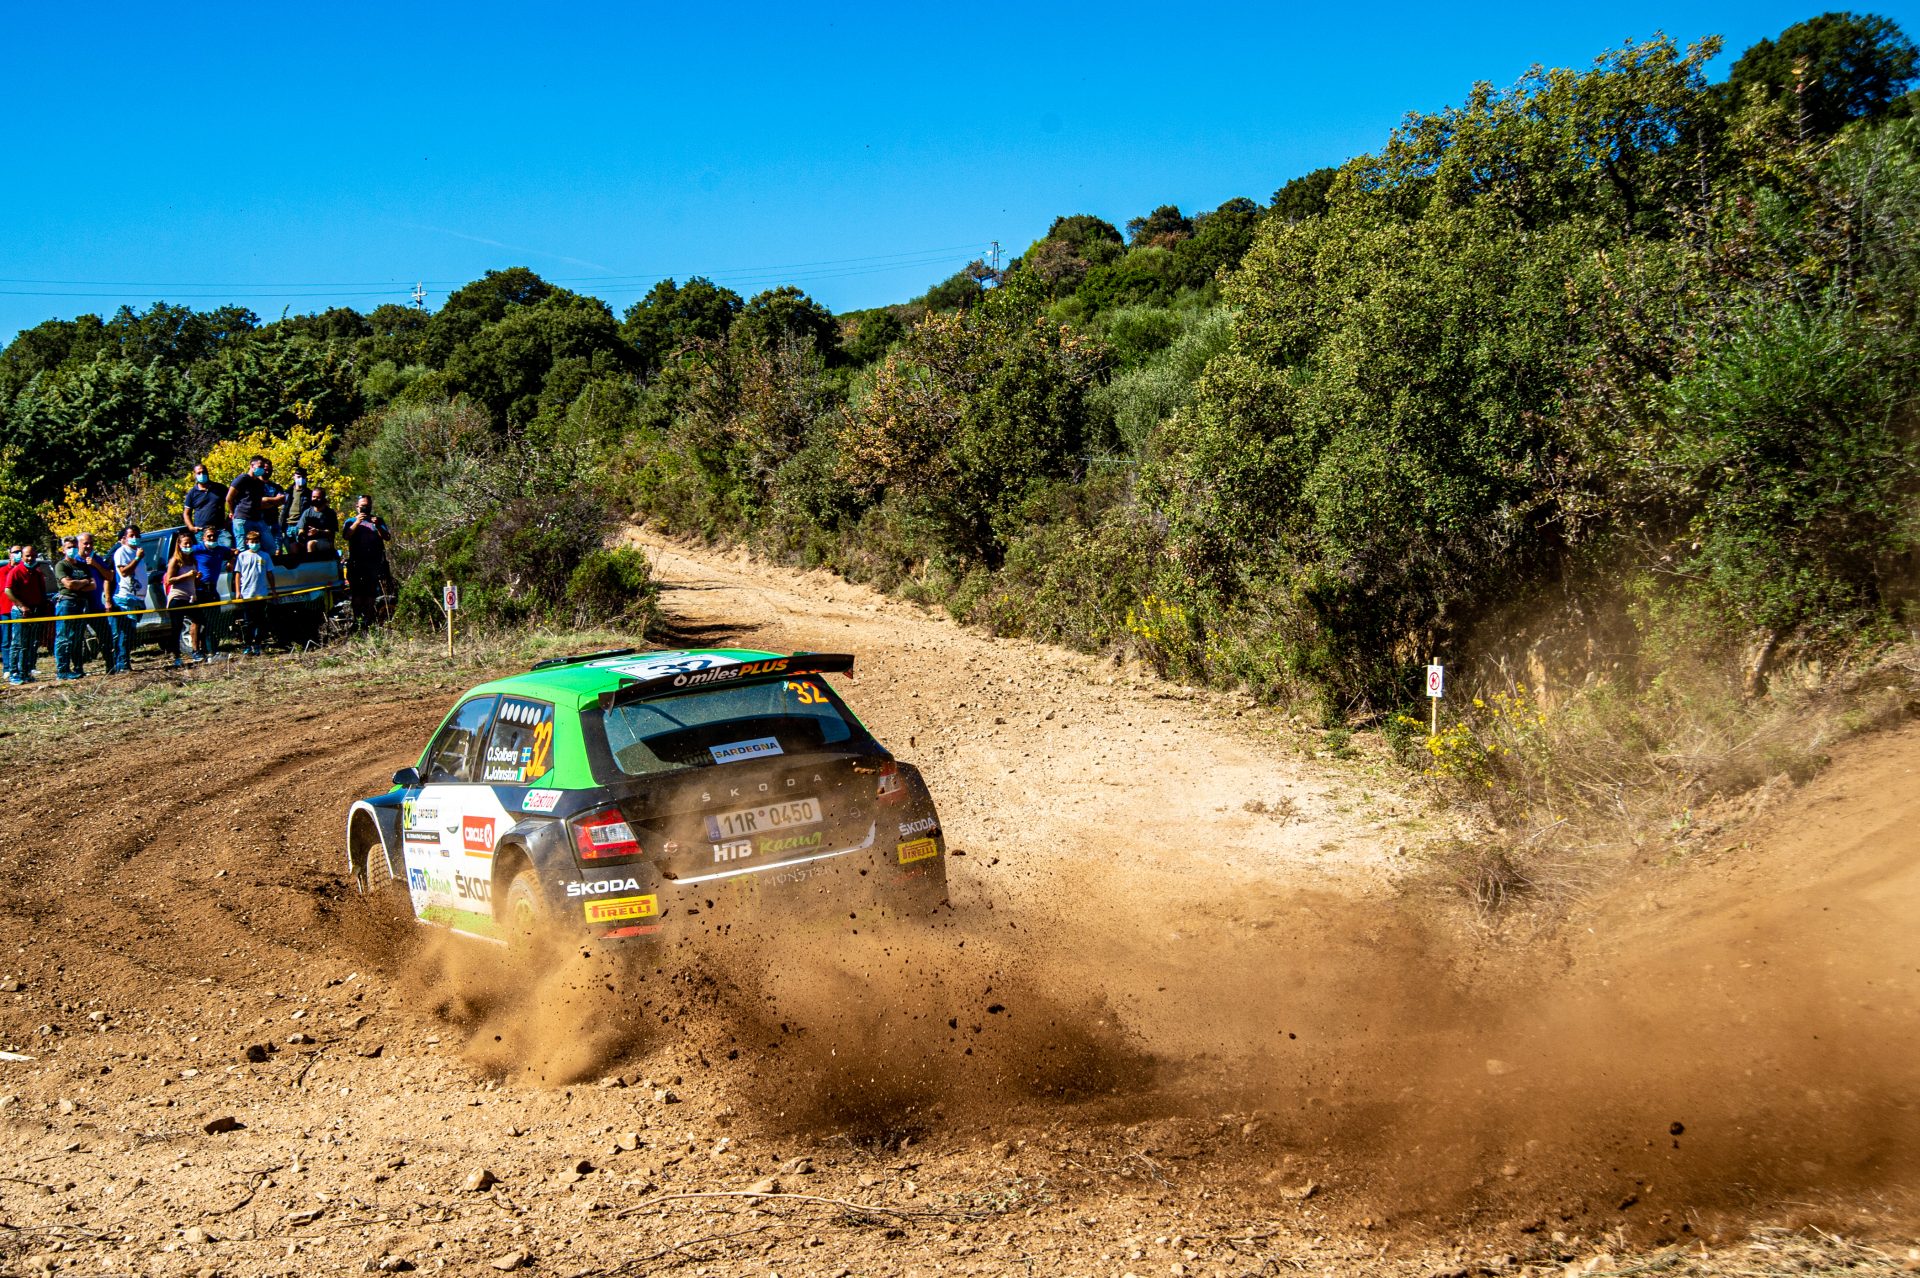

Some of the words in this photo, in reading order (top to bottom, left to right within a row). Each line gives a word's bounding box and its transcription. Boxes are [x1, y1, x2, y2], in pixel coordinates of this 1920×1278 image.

[788, 681, 829, 704] 32
[526, 721, 553, 777] 32
[714, 742, 778, 759] SARDEGNA
[529, 791, 558, 808] Castrol
[723, 811, 757, 834] 11R
[769, 802, 813, 826] 0450
[464, 826, 485, 842] CIRCLE
[713, 840, 752, 862] HTB
[902, 841, 935, 859] PIRELLI
[566, 878, 640, 897] ŠKODA
[591, 899, 651, 919] PIRELLI
